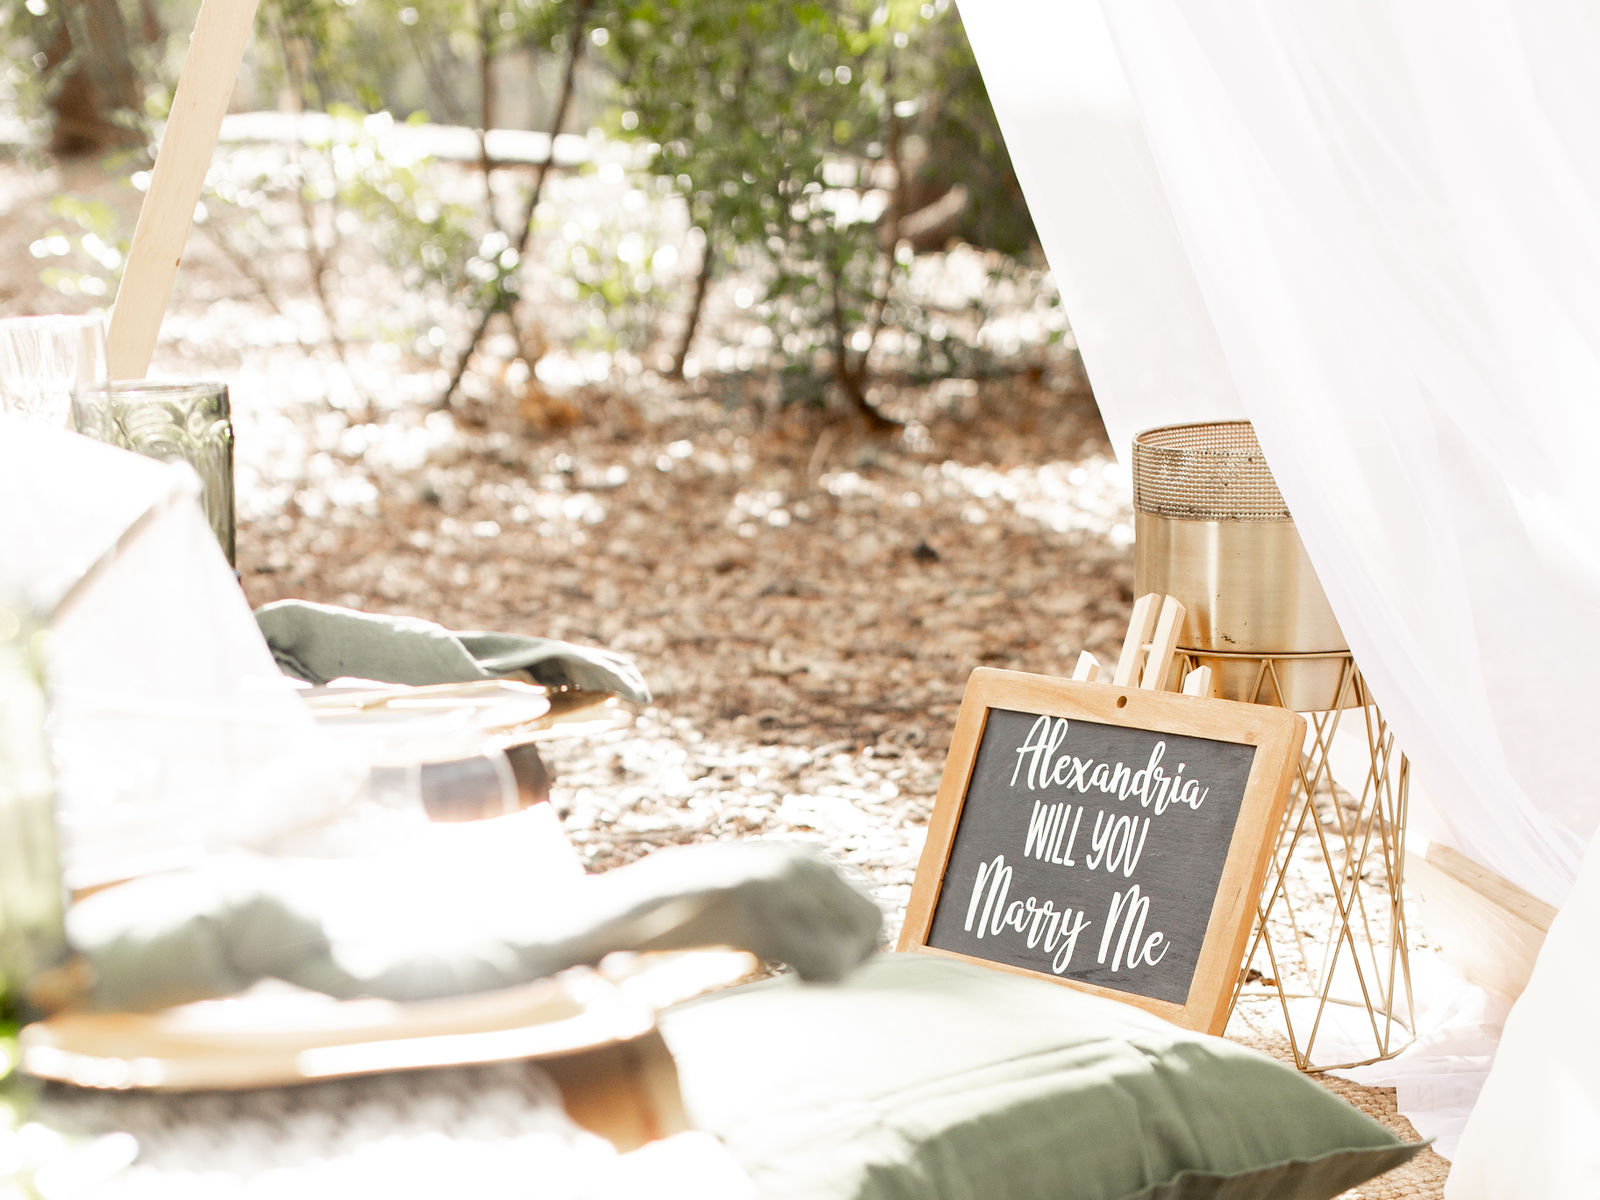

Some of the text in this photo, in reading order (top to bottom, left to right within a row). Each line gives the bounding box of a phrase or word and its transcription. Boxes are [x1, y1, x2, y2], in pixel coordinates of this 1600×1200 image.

[1010, 715, 1209, 816] Alexandria
[1024, 800, 1151, 878] WILL YOU
[964, 854, 1171, 975] Marry Me
